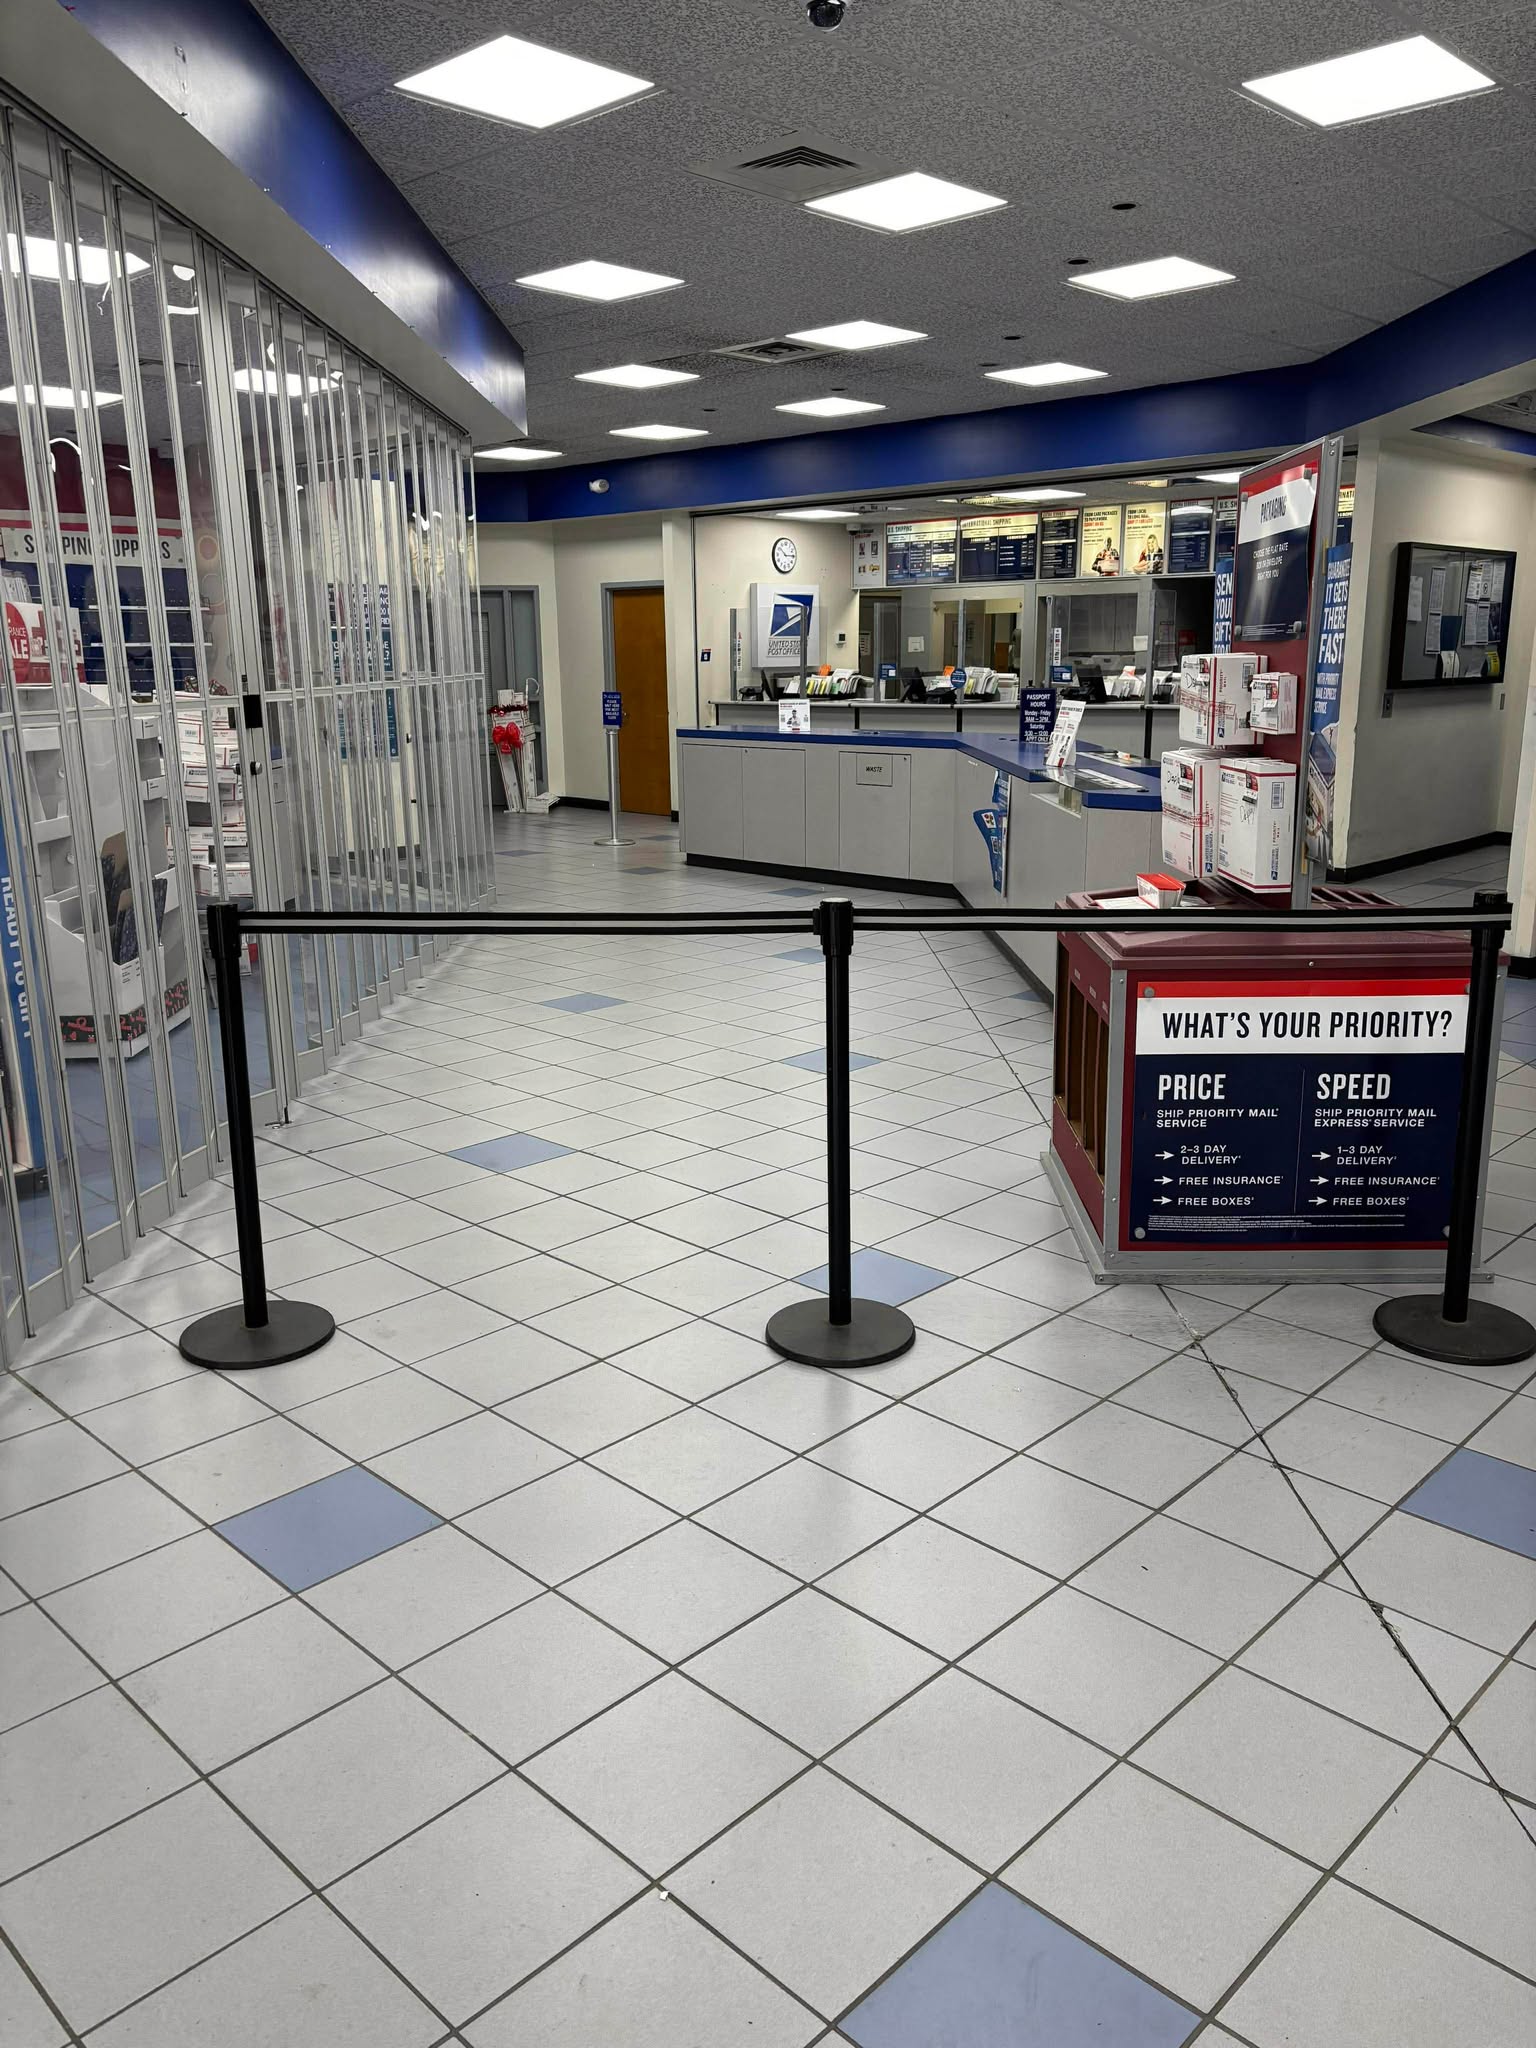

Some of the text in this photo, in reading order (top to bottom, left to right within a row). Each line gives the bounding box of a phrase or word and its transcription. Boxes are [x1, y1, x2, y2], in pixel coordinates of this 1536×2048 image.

[1261, 496, 1287, 523] PACKAGING
[993, 517, 1012, 526] SHIPPING
[895, 525, 912, 533] SHIPPING
[24, 534, 92, 555] SPIN
[1216, 573, 1233, 596] SEN
[1325, 580, 1348, 604] IT GETS
[1323, 605, 1347, 630] THERE
[8, 626, 26, 637] RANCE
[11, 638, 29, 659] LE
[768, 640, 789, 648] UNITED
[1318, 633, 1345, 665] FAST
[768, 647, 801, 656] POST OFFICE
[1162, 1010, 1453, 1039] WHAT'S YOUR PRIORITY?
[1158, 1073, 1227, 1100] PRICE
[1316, 1073, 1391, 1100] SPEED
[1156, 1109, 1184, 1118] SHIP
[1188, 1108, 1244, 1118] PRIORITY
[1314, 1108, 1437, 1117] SHIP PRIORITY MAIL
[1156, 1119, 1207, 1128] SERVICE
[1373, 1118, 1425, 1127] SERVICE
[1180, 1144, 1227, 1154] 2-3 DAY
[1337, 1145, 1383, 1154] 1-3 DAY
[1179, 1177, 1208, 1185] FREE
[1334, 1177, 1364, 1185] FREE
[1178, 1197, 1208, 1206] FREE
[1332, 1197, 1362, 1206] FREE
